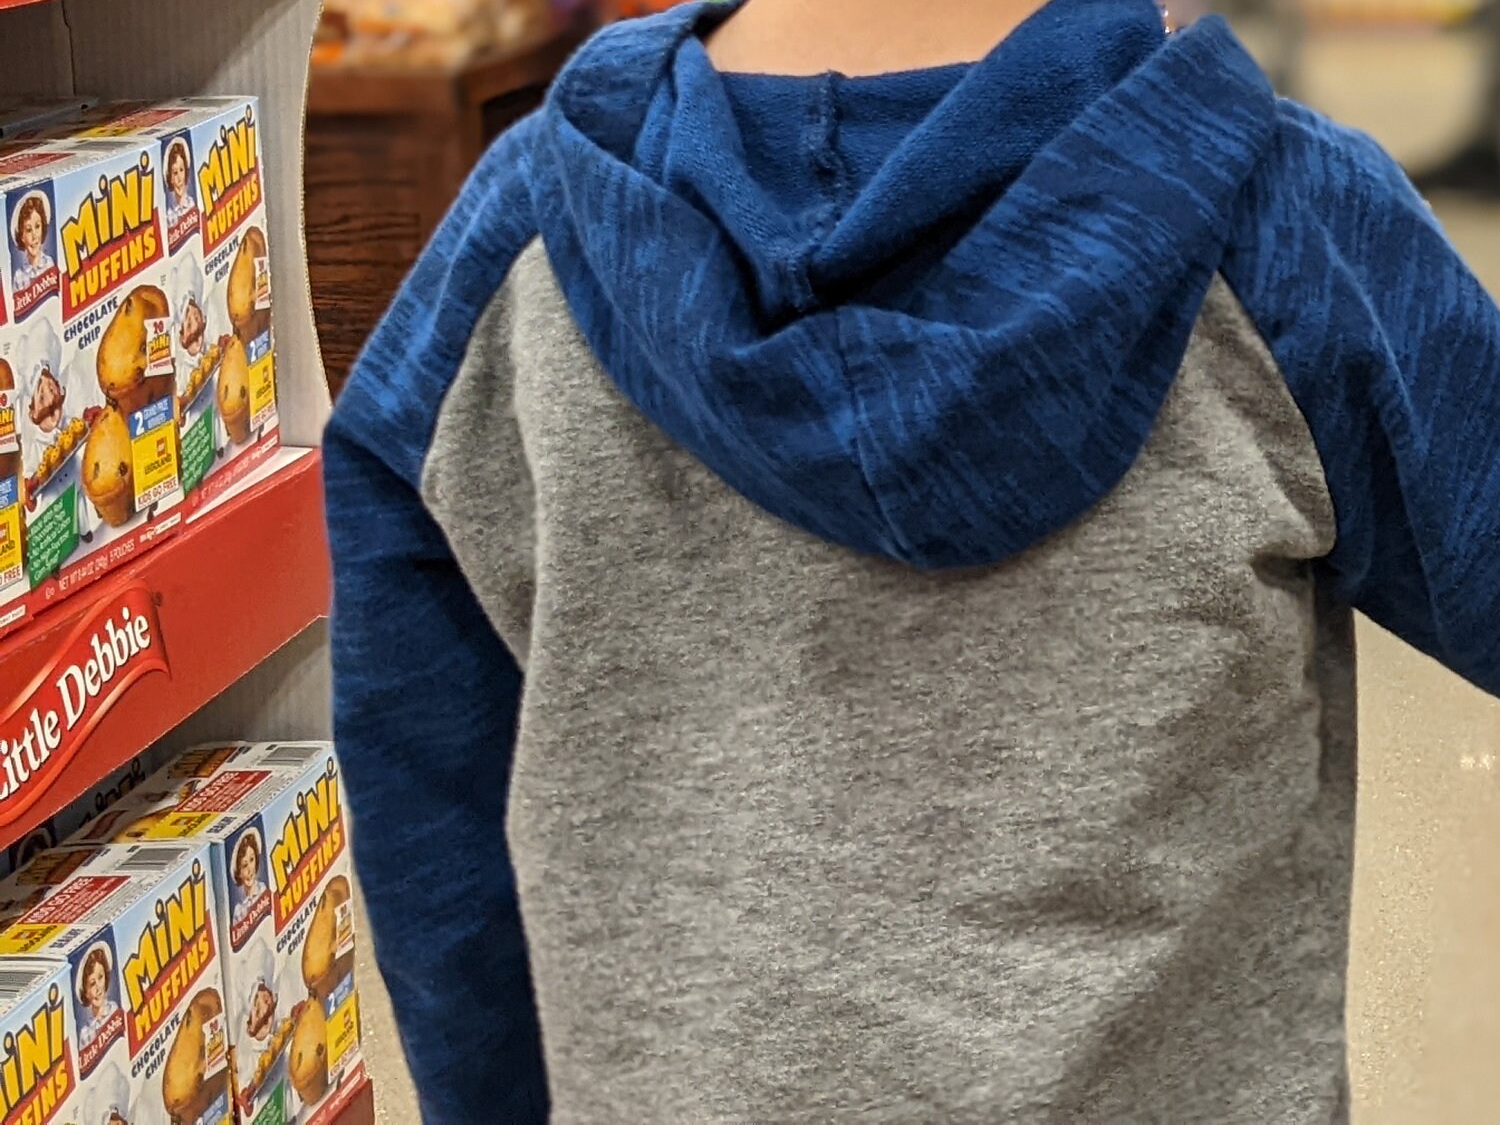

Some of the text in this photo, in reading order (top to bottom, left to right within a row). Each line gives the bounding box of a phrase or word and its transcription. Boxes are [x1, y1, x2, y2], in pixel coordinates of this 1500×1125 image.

[207, 173, 259, 245] MUFFINS
[70, 225, 156, 309] MUFFINS
[204, 236, 240, 276] CHOCOLATE
[215, 261, 229, 283] CHIP
[32, 272, 58, 299] Debbie
[63, 296, 119, 343] CHOCOLATE
[78, 325, 101, 351] CHIP
[134, 411, 145, 436] 2
[137, 476, 178, 506] KIDS GO FREE
[4, 565, 21, 582] FREE
[56, 606, 151, 732] Debbie
[280, 821, 341, 920] MUFFINS
[249, 895, 271, 927] Debbie
[276, 894, 318, 954] CHOCOLATE
[287, 930, 306, 956] CHIP
[135, 928, 210, 1042] MUFFINS
[98, 1014, 124, 1048] Debbie
[131, 1012, 182, 1079] CHOCOLATE
[145, 1048, 167, 1080] CHIP
